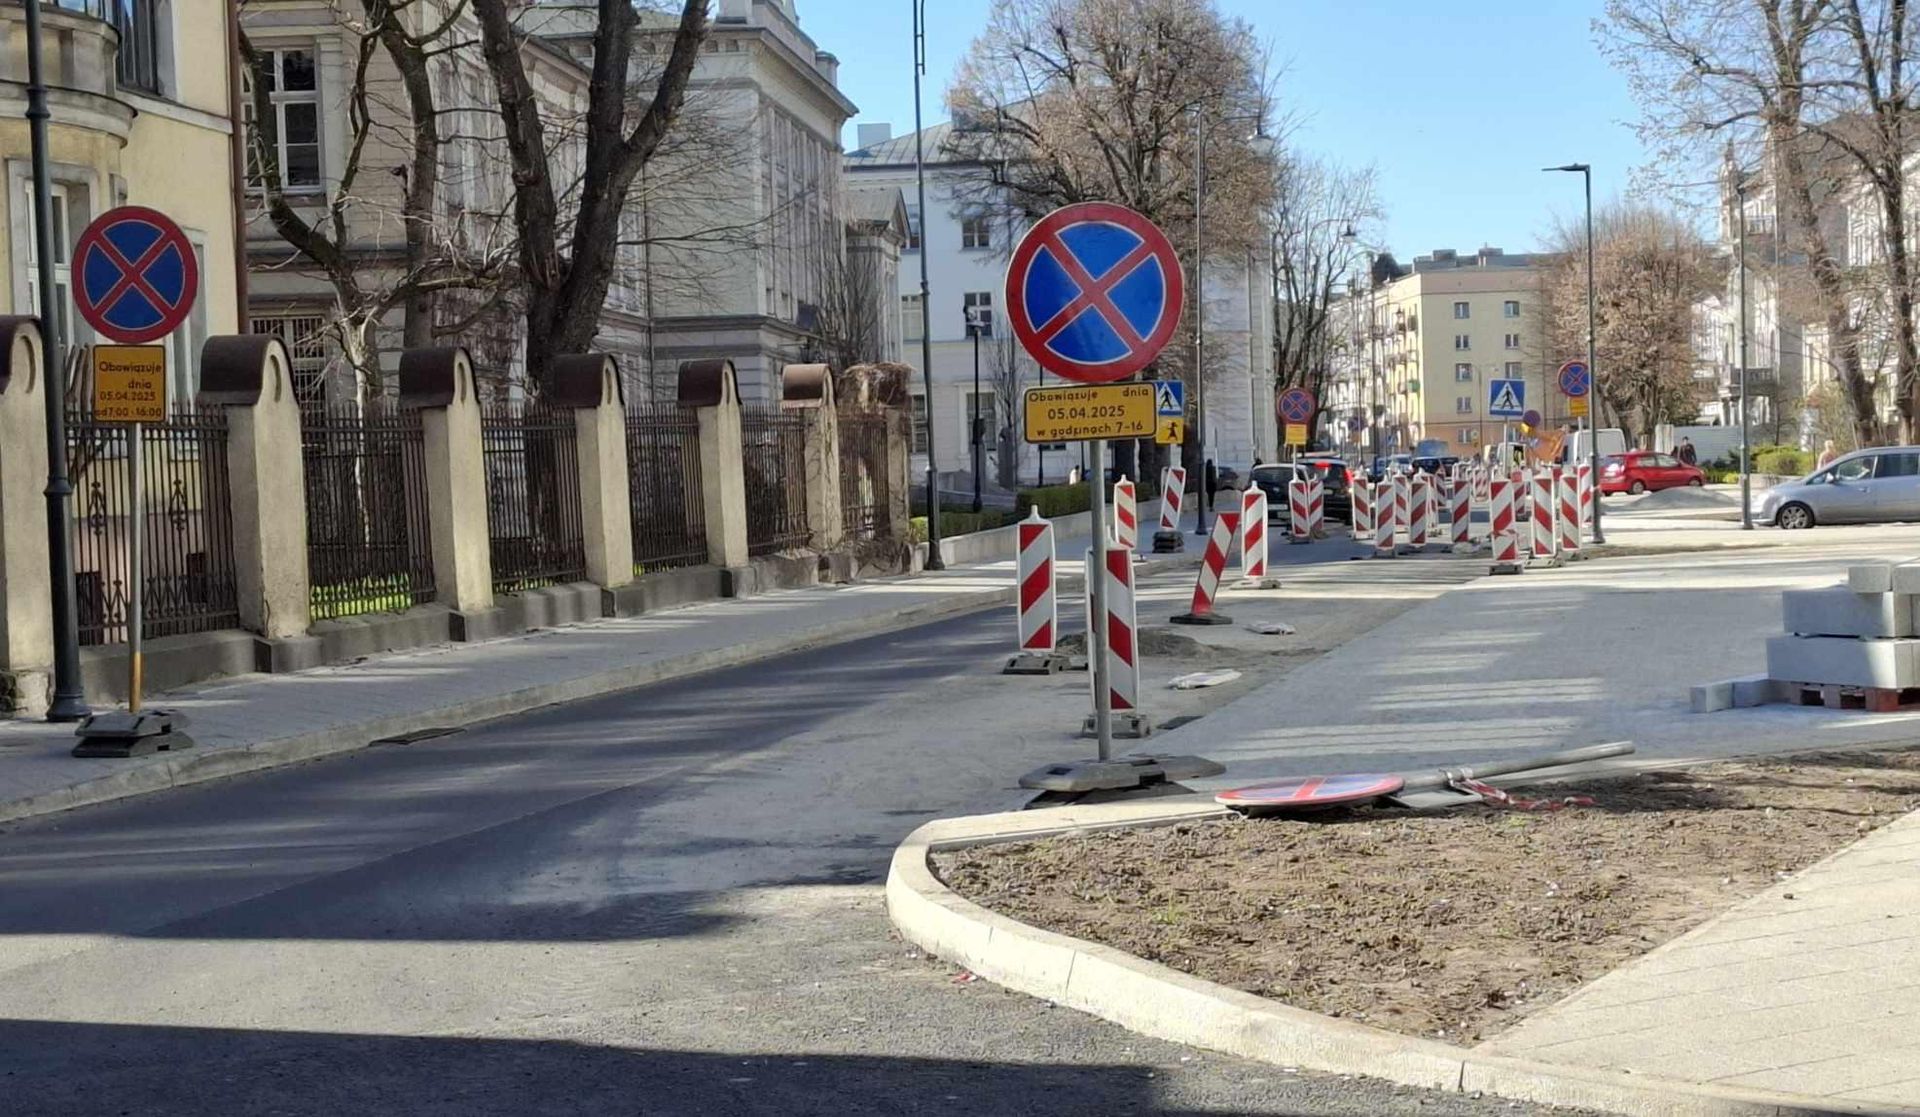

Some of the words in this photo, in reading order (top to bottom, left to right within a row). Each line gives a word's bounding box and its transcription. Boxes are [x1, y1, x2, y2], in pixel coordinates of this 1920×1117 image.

[99, 361, 162, 374] Obowiązuje
[128, 378, 152, 389] dnia
[99, 391, 156, 401] 05.04.2025
[1029, 390, 1098, 402] Obowiązuje
[1122, 387, 1149, 397] dnia
[1047, 405, 1125, 420] 05.04.2025
[1050, 423, 1111, 437] godzinach
[1115, 421, 1143, 432] 7-16
